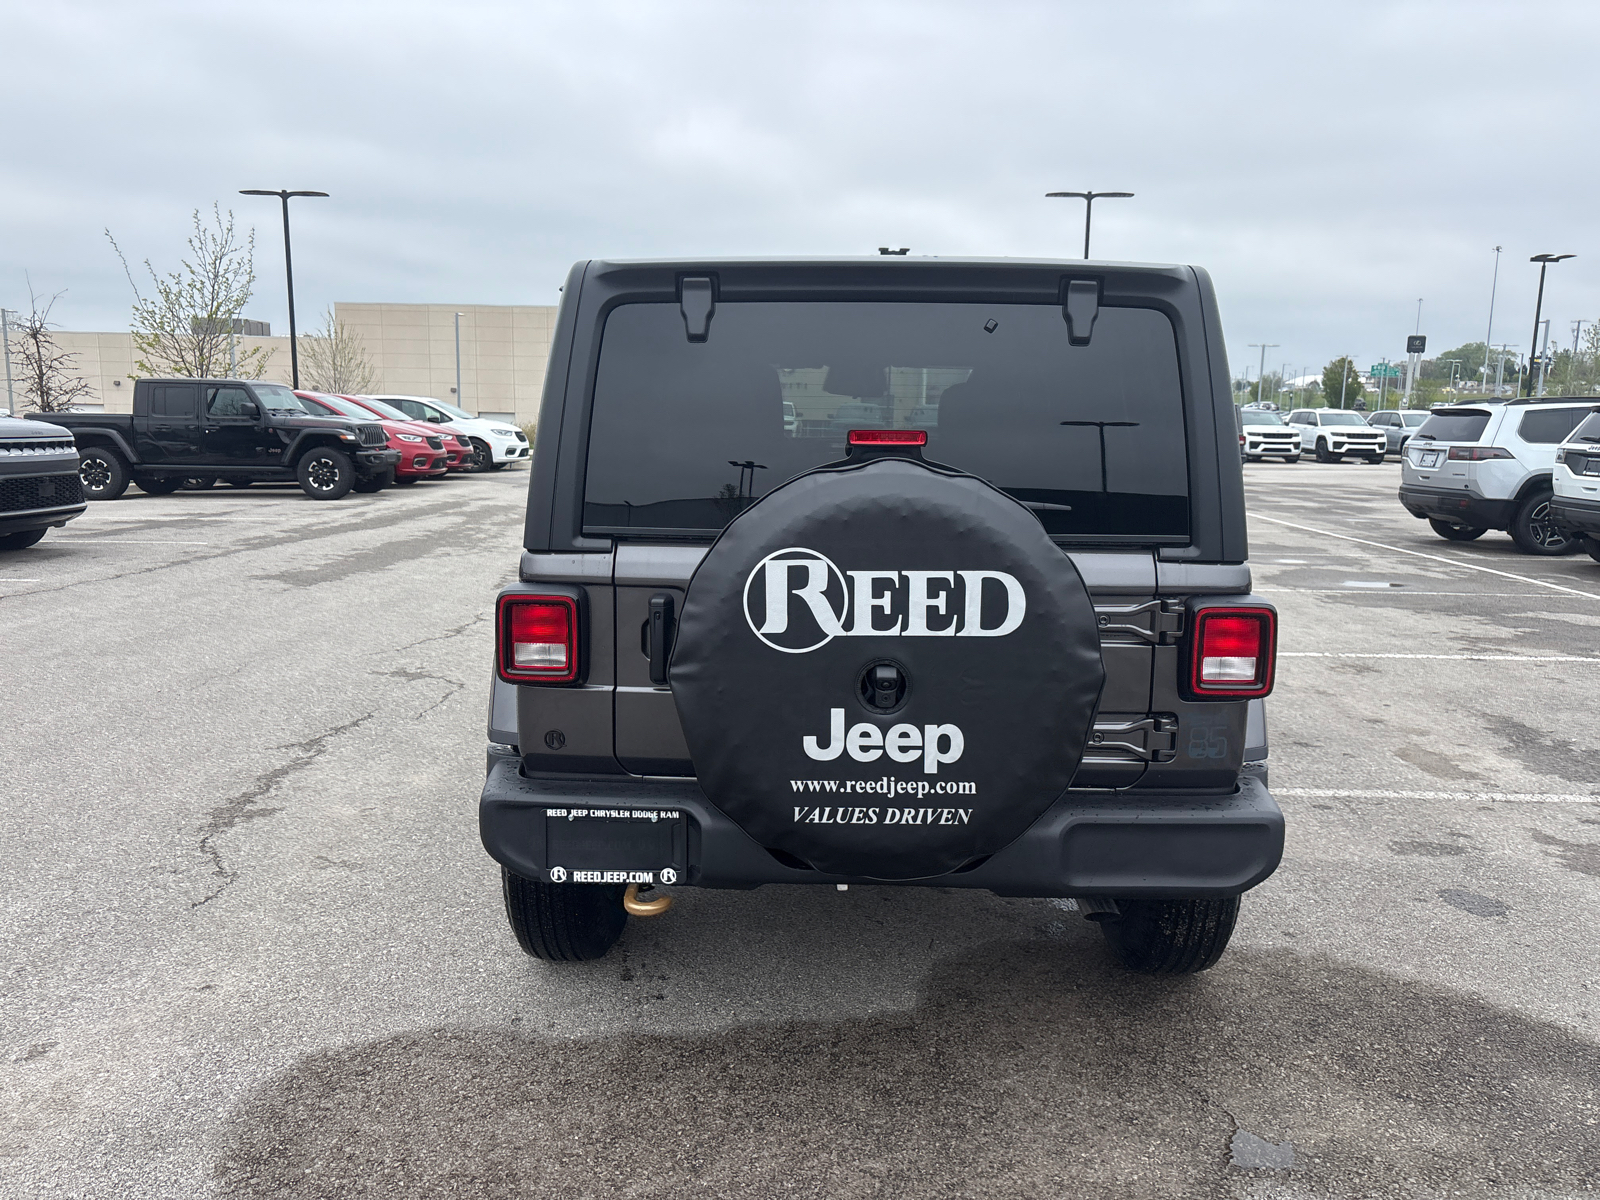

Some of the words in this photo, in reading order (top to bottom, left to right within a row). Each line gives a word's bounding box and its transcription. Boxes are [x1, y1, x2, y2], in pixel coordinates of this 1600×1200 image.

[745, 550, 1026, 640] REED
[803, 708, 965, 774] Jeep
[790, 776, 977, 799] www.reedjeep.com
[547, 809, 567, 817] REED
[570, 809, 588, 817] JEEP
[590, 810, 631, 818] CHRYSLER
[632, 810, 659, 819] DODGE
[660, 811, 679, 819] RAM
[792, 806, 880, 825] VALUES
[883, 807, 973, 825] DRIVEN
[573, 871, 653, 883] REEDJEEP.COM
